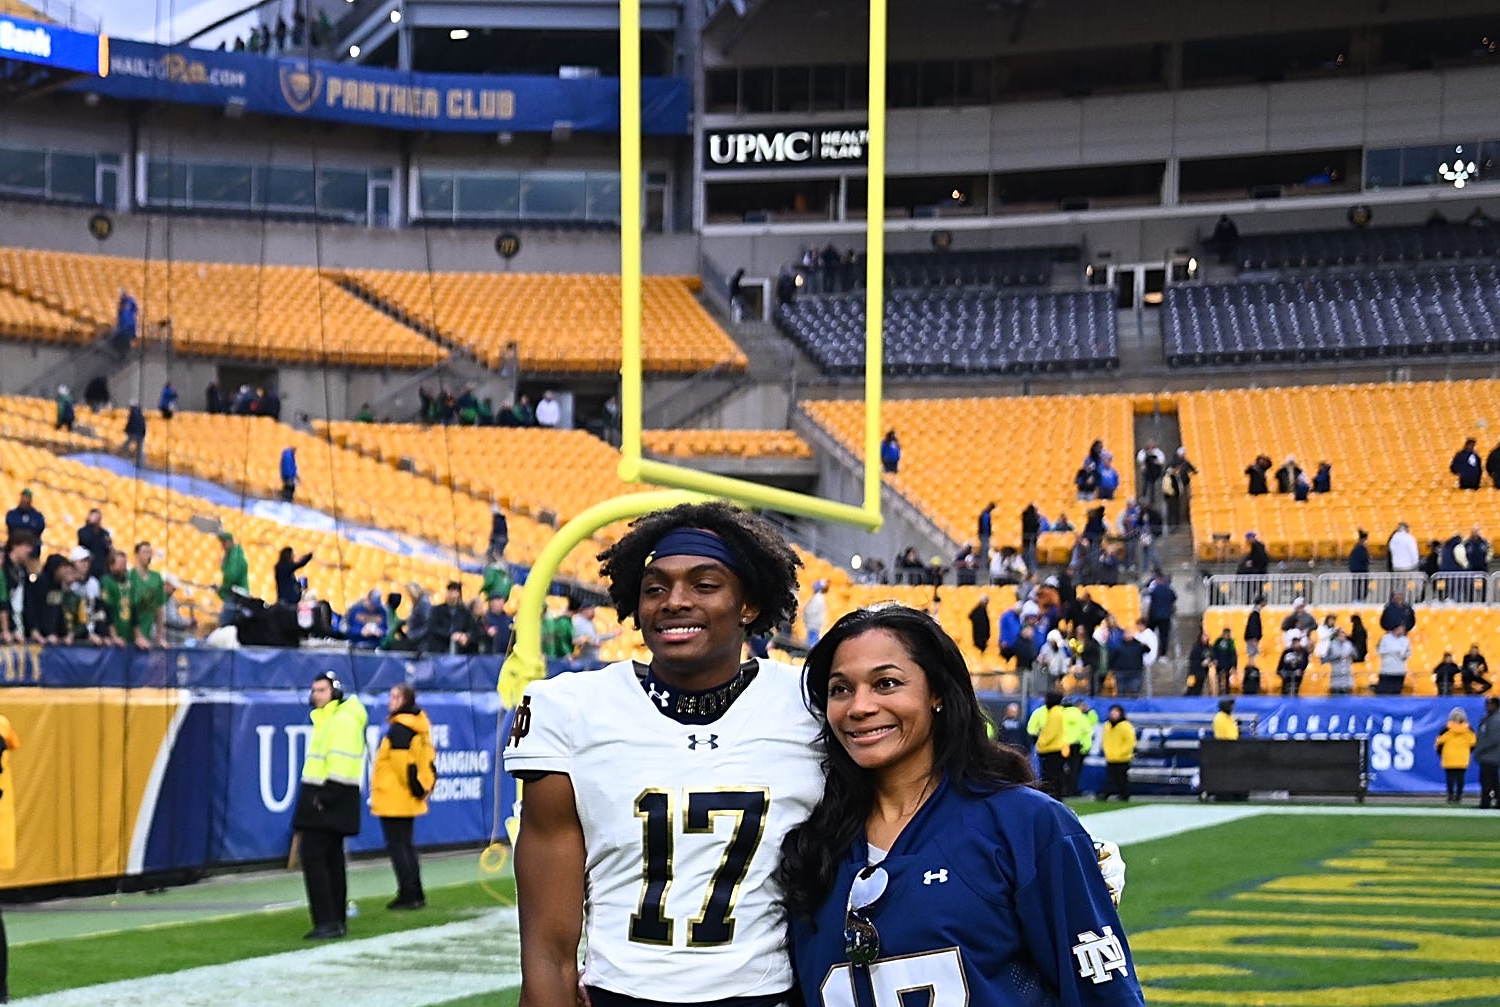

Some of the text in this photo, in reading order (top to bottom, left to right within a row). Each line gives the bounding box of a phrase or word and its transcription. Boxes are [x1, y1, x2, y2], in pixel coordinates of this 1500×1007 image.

[0, 20, 51, 57] Bank
[326, 77, 515, 119] PANTHER CLUB
[710, 131, 810, 164] UPMC
[820, 145, 862, 160] PLAN
[431, 724, 450, 748] FE
[1268, 713, 1414, 735] COMPLISH
[434, 749, 489, 775] ANGING
[628, 786, 771, 948] 17
